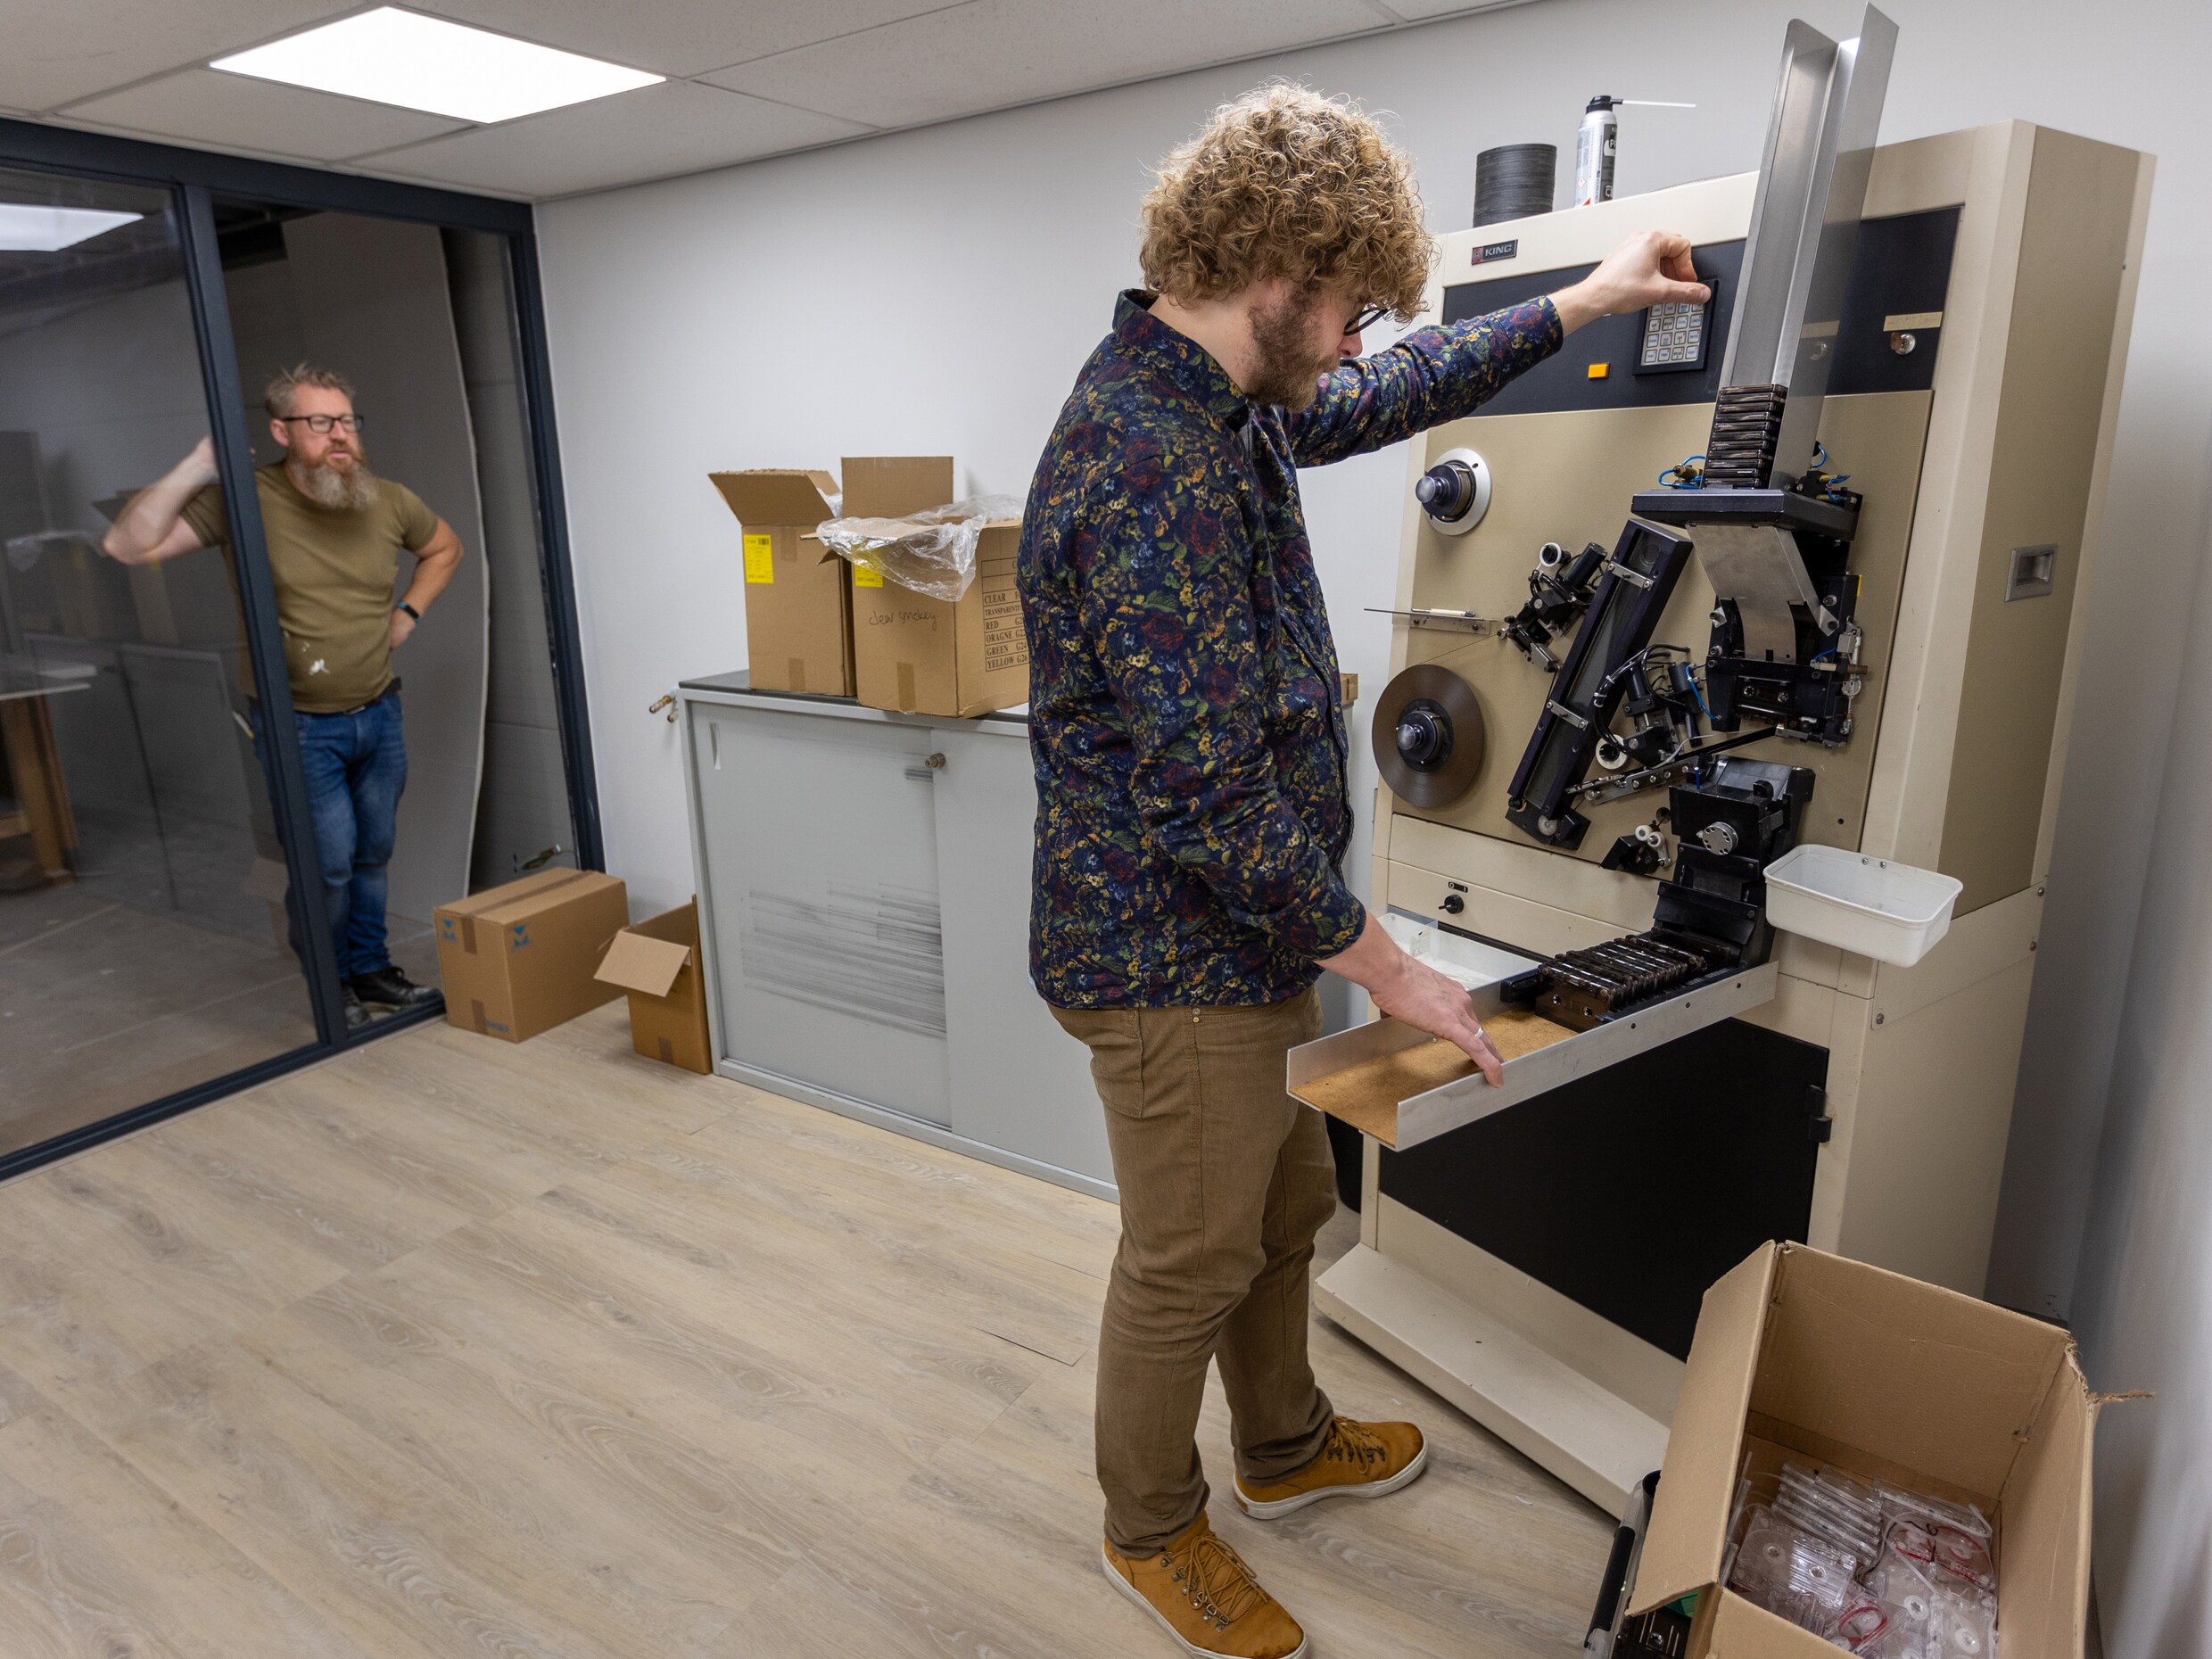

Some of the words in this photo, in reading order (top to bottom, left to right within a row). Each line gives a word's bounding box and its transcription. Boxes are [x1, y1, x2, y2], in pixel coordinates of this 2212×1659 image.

[1485, 244, 1512, 257] KING
[984, 593, 1006, 605] CLEAR
[986, 620, 999, 631] RED
[986, 631, 1013, 643] ORAGNE
[986, 645, 1009, 656] GREEN
[987, 656, 1015, 669] YELLOW
